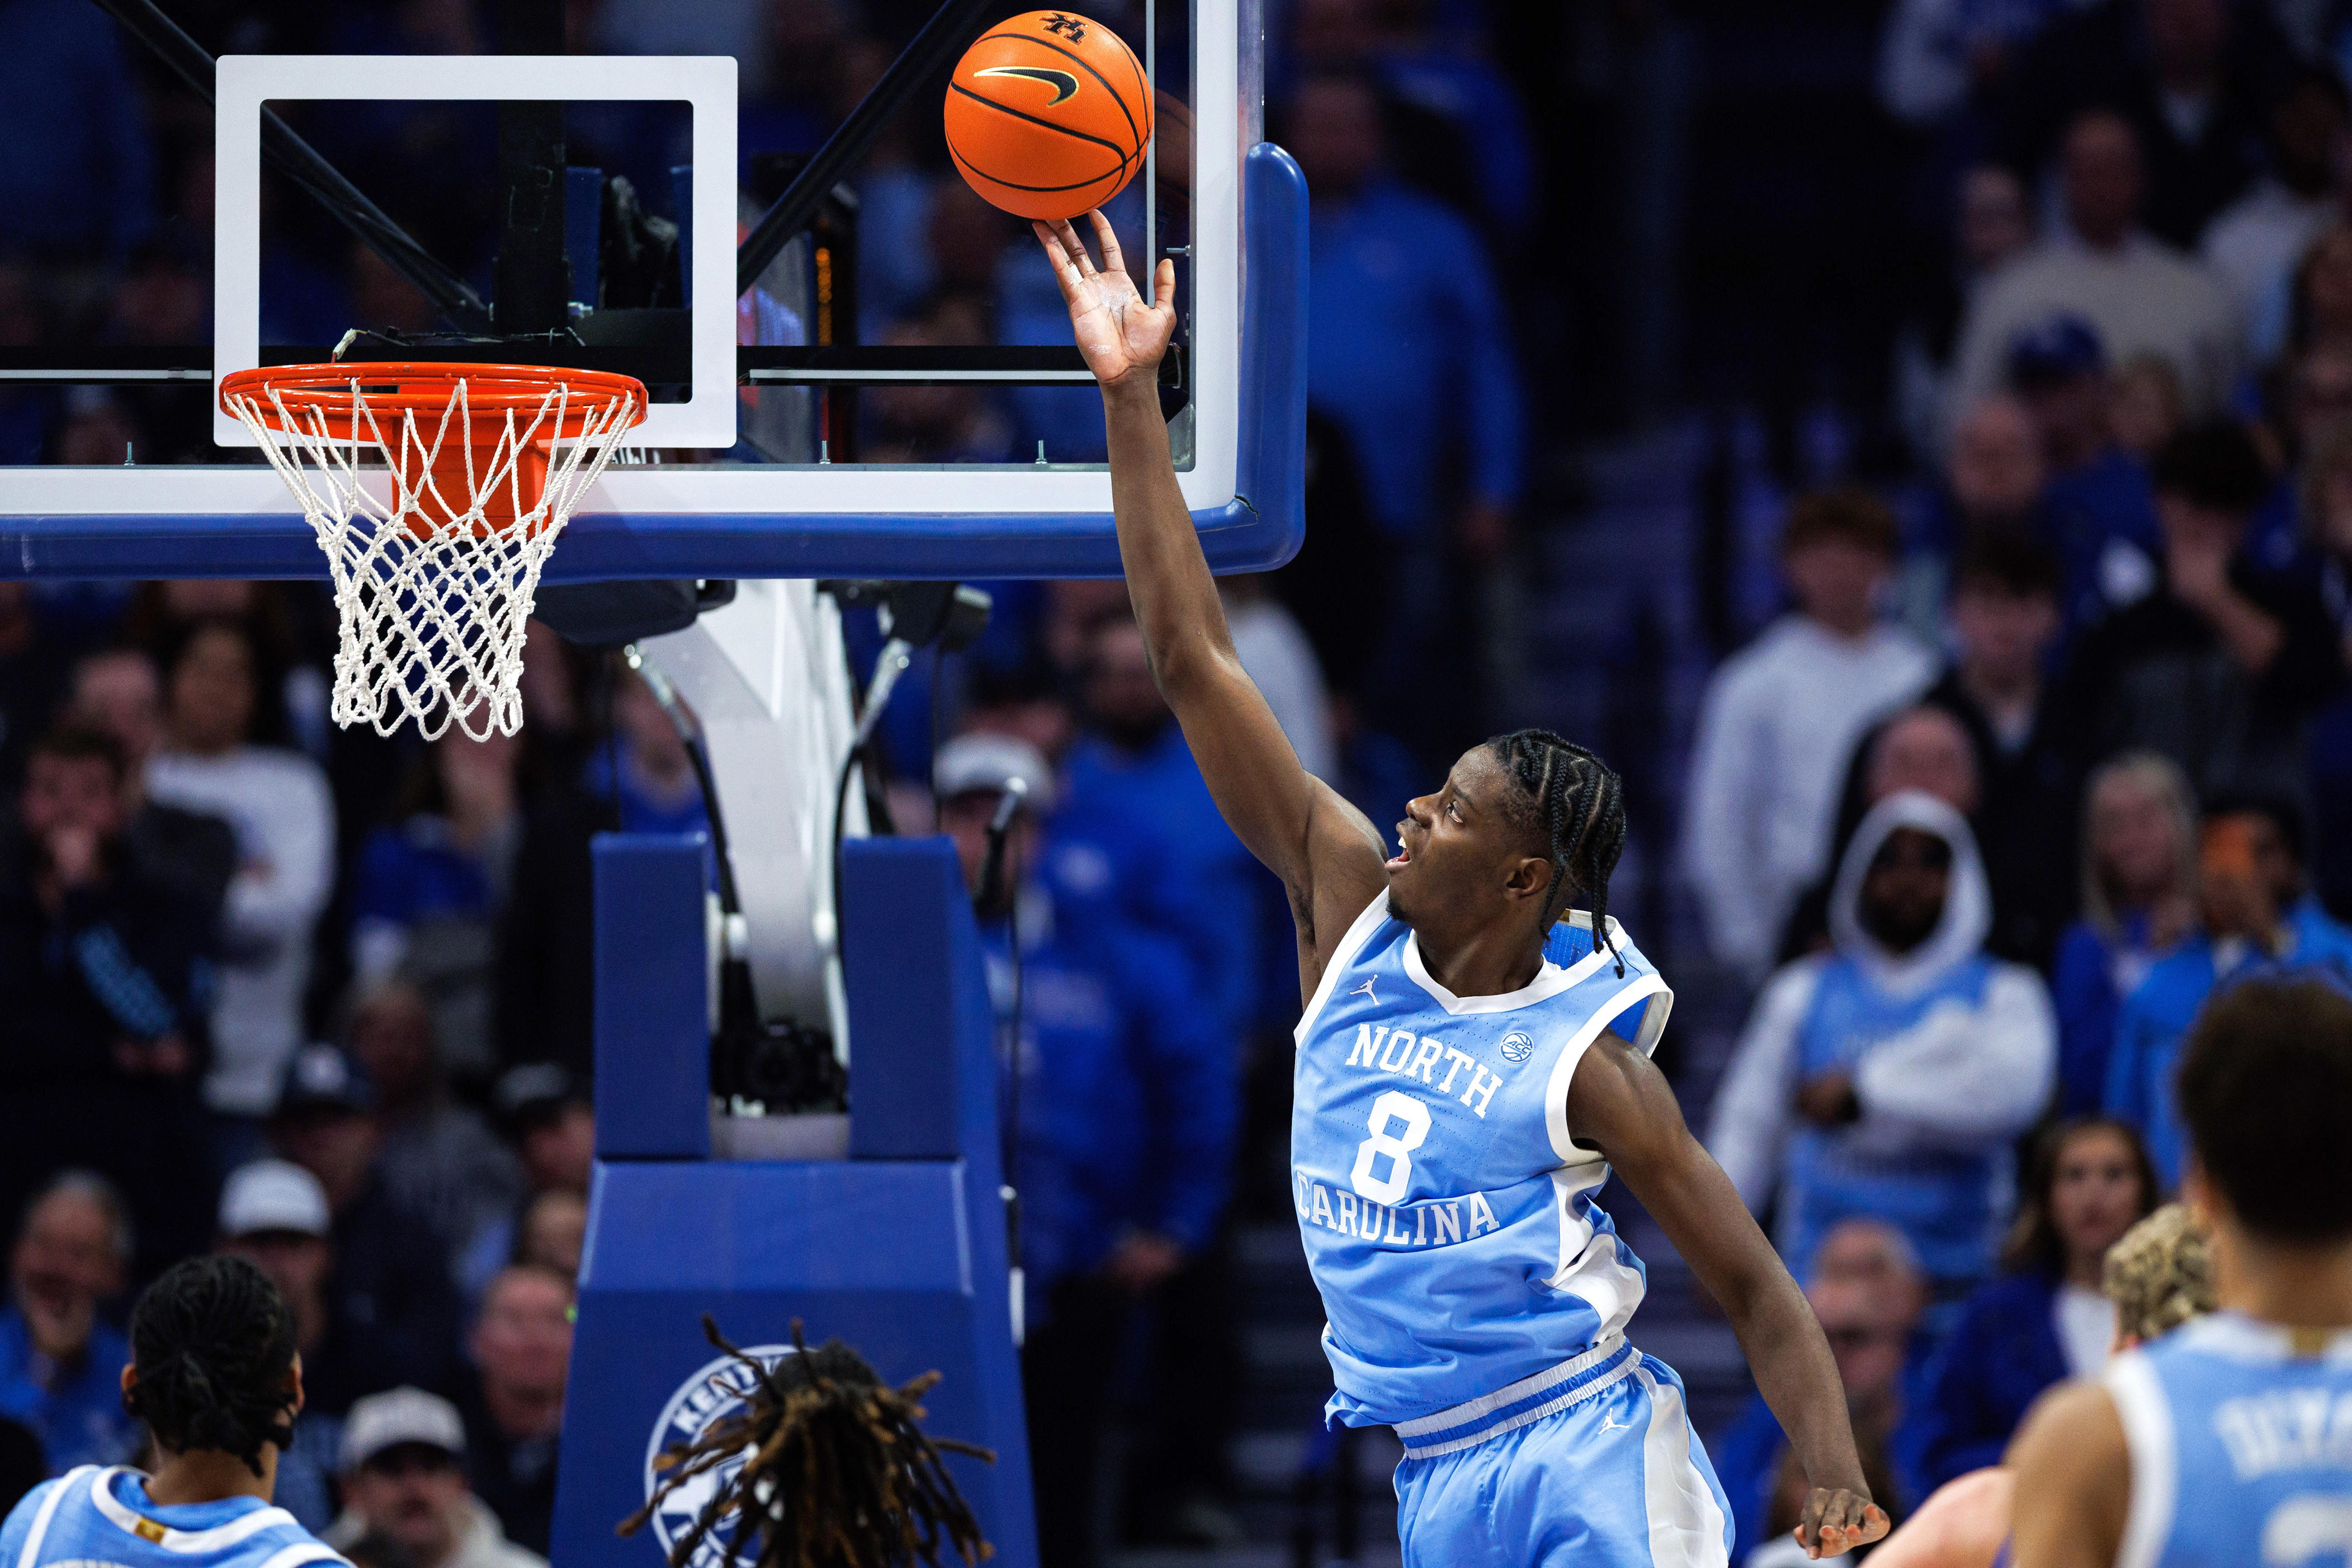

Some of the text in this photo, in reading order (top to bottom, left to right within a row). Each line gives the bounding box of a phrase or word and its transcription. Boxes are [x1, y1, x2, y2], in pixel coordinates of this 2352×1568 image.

[1345, 1023, 1504, 1119] NORTH
[1506, 1040, 1532, 1054] ACC
[1350, 1089, 1433, 1207] 8
[1296, 1172, 1501, 1246] CAROLINA
